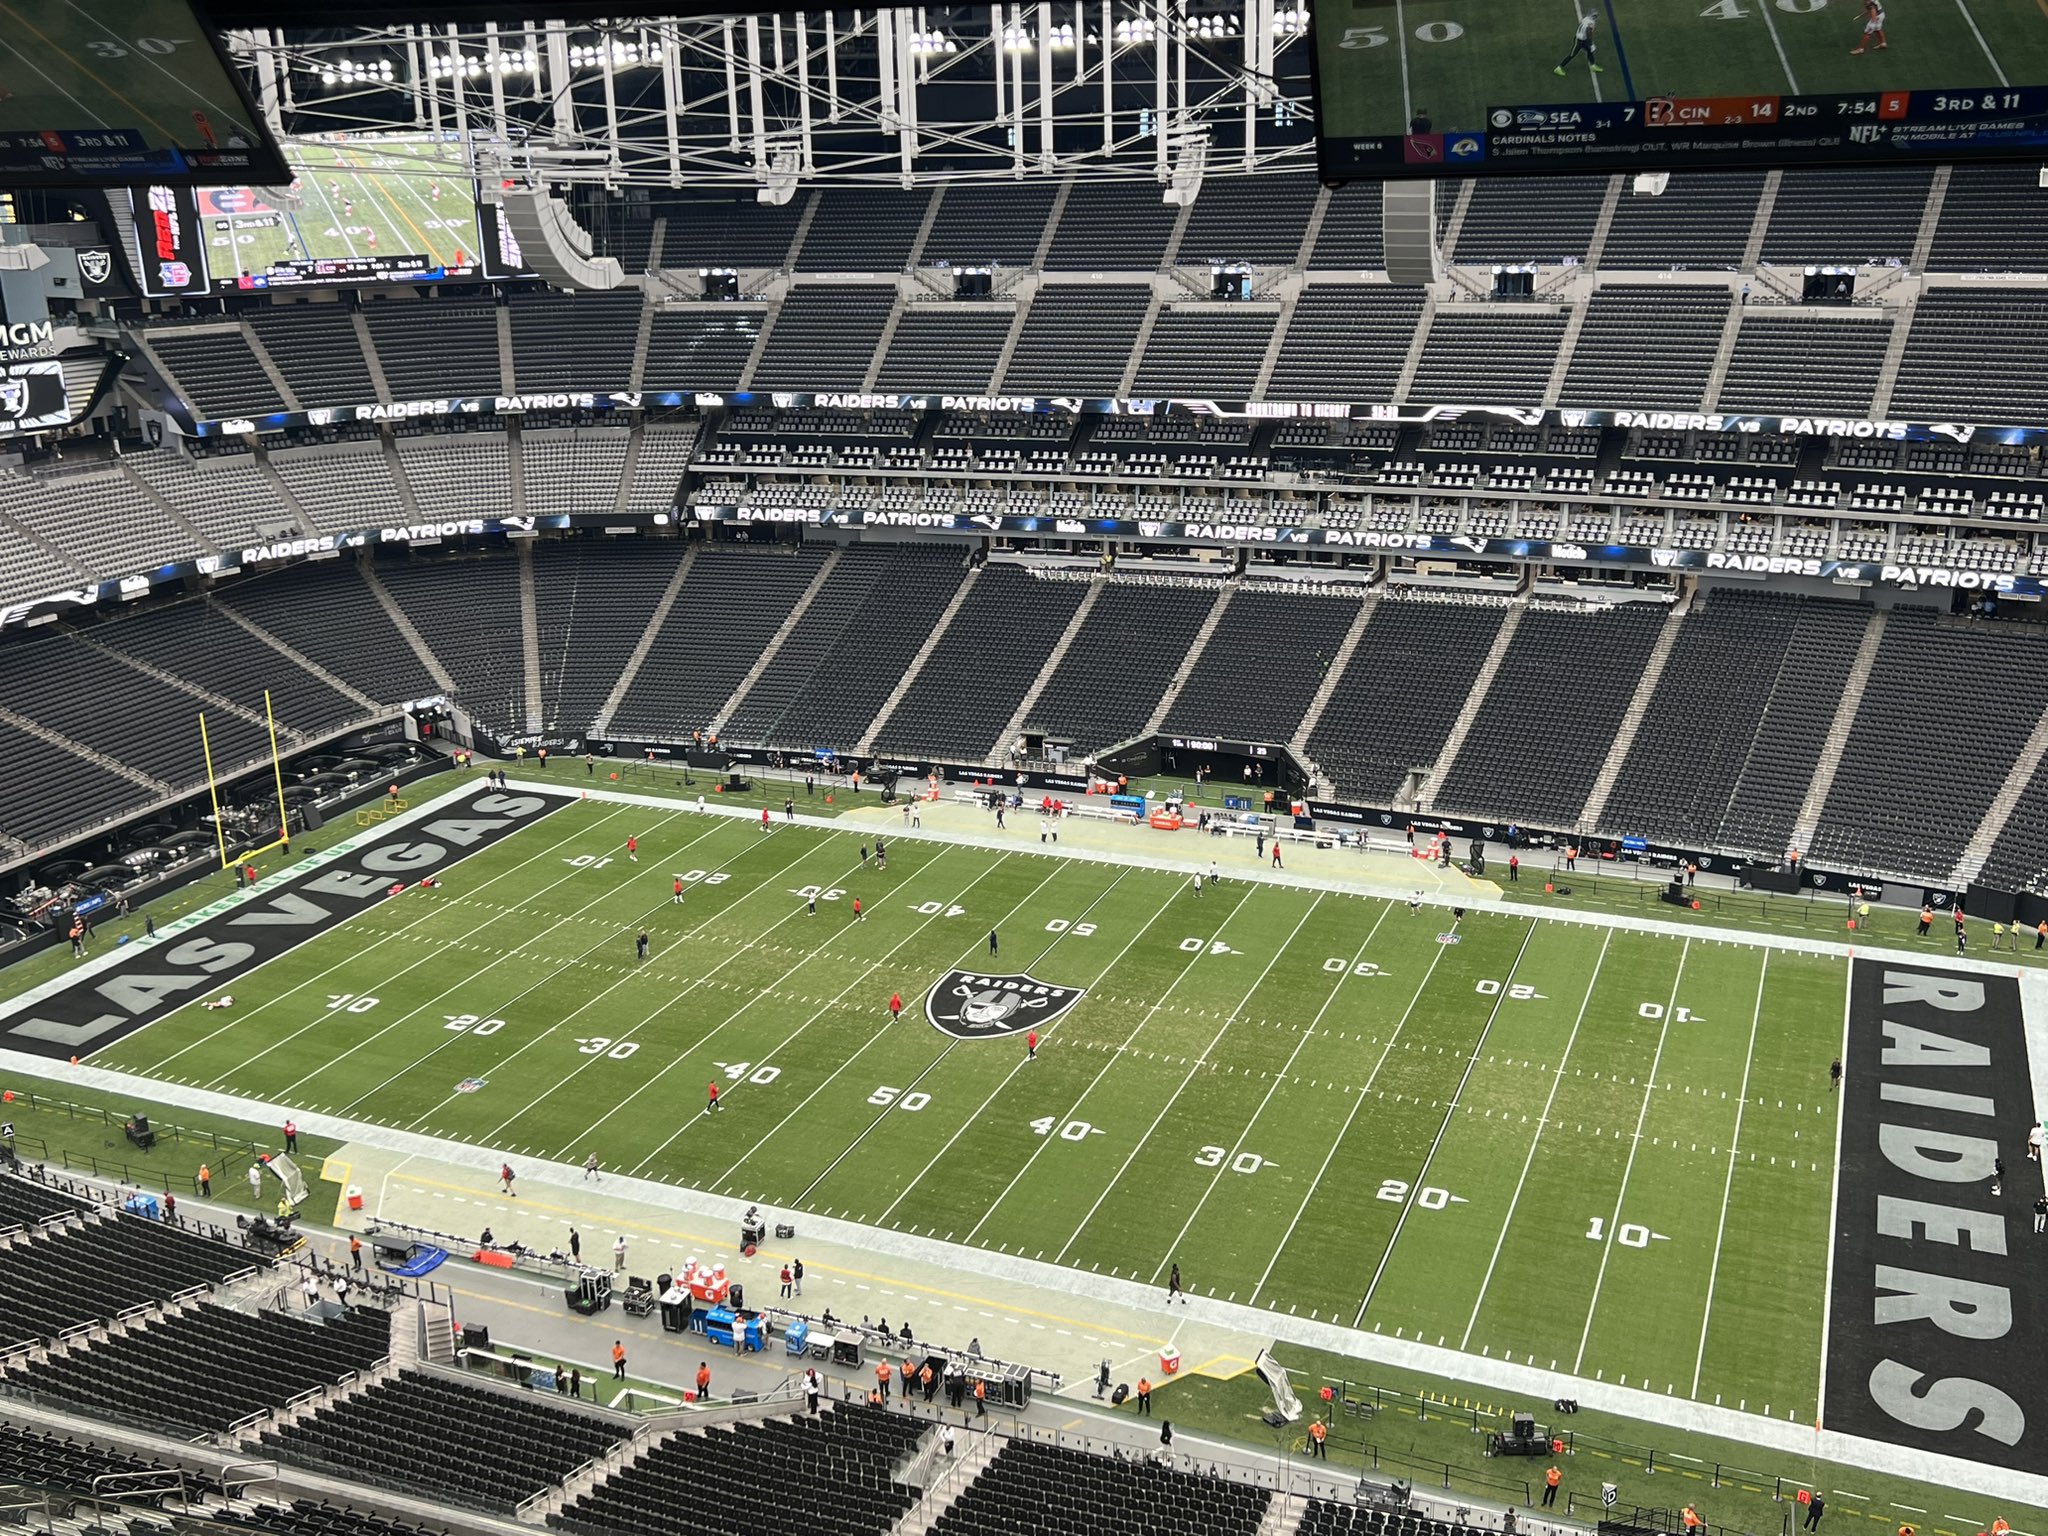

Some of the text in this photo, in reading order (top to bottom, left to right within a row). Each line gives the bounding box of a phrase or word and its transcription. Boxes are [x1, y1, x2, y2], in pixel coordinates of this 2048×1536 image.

[87, 37, 176, 58] 30
[1338, 22, 1463, 49] 50
[1550, 112, 1582, 123] SEA
[1623, 109, 1636, 122] 7
[1679, 107, 1710, 119] CIN
[1724, 116, 1742, 124] 2-3
[1752, 104, 1772, 117] 14
[1784, 105, 1818, 116] 2ND
[1837, 102, 1876, 114] 7:54
[1888, 101, 1899, 111] 5
[1933, 97, 1974, 111] 3RD
[1981, 94, 1996, 110] &
[2003, 94, 2020, 109] 11
[1492, 133, 1596, 145] CARDINALS NOTES
[1892, 125, 1947, 133] STREAM
[1979, 122, 2025, 130] GAMES
[1910, 133, 1955, 141] MOBILE
[75, 135, 102, 147] 3RD
[355, 400, 448, 420] RAIDERS
[495, 393, 594, 411] PATRIOTS
[814, 393, 899, 408] RAIDERS
[941, 396, 1035, 411] PATRIOTS
[1301, 403, 1312, 417] TO
[1314, 403, 1351, 417] KICKOFF
[1613, 411, 1725, 431] RAIDERS
[1780, 418, 1909, 439] PATRIOTS
[737, 507, 821, 522] RAIDERS
[863, 511, 956, 528] PATRIOTS
[242, 536, 334, 564] RAIDERS
[381, 519, 484, 542] PATRIOTS
[1185, 523, 1278, 543] RAIDERS
[1325, 530, 1433, 550] PATRIOTS
[1707, 552, 1822, 576] RAIDERS
[1880, 565, 2016, 593] PATRIOTS
[167, 896, 244, 930] TAKES
[251, 873, 292, 894] ALL
[293, 858, 323, 872] OF
[330, 843, 356, 857] US
[1861, 883, 1882, 891] VEGAS
[8, 794, 547, 1046] LAS VEGAS
[960, 975, 1065, 998] RAIDERS
[329, 993, 380, 1013] 10
[446, 1014, 505, 1036] 20
[580, 1037, 640, 1060] 30
[723, 1062, 782, 1085] 40
[867, 1086, 932, 1112] 50
[1030, 1116, 1092, 1143] 40
[1194, 1146, 1265, 1174] 30
[1376, 1179, 1450, 1211] 20
[1869, 970, 2026, 1446] RAIDERS
[1586, 1216, 1650, 1248] 10
